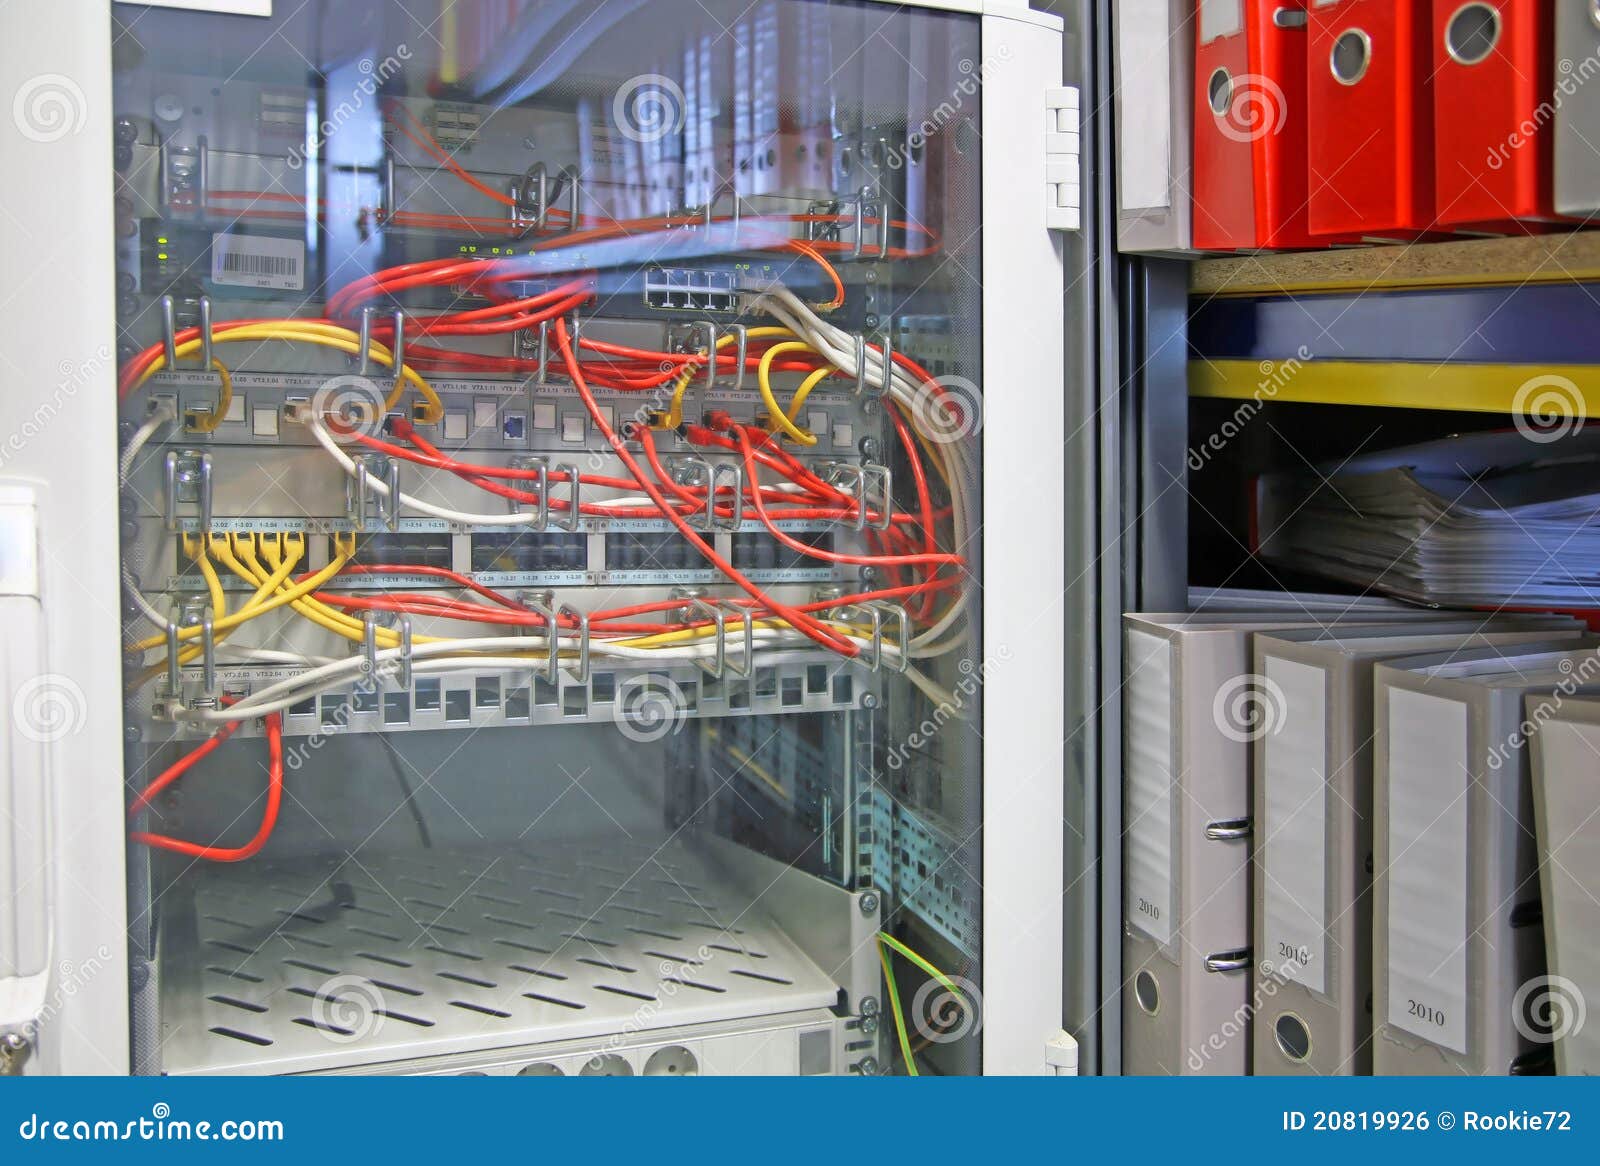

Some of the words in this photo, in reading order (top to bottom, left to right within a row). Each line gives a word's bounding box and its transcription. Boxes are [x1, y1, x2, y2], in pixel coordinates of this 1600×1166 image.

[1139, 898, 1159, 921] 2010
[1279, 942, 1308, 966] 2010
[1408, 1000, 1445, 1026] 2010
